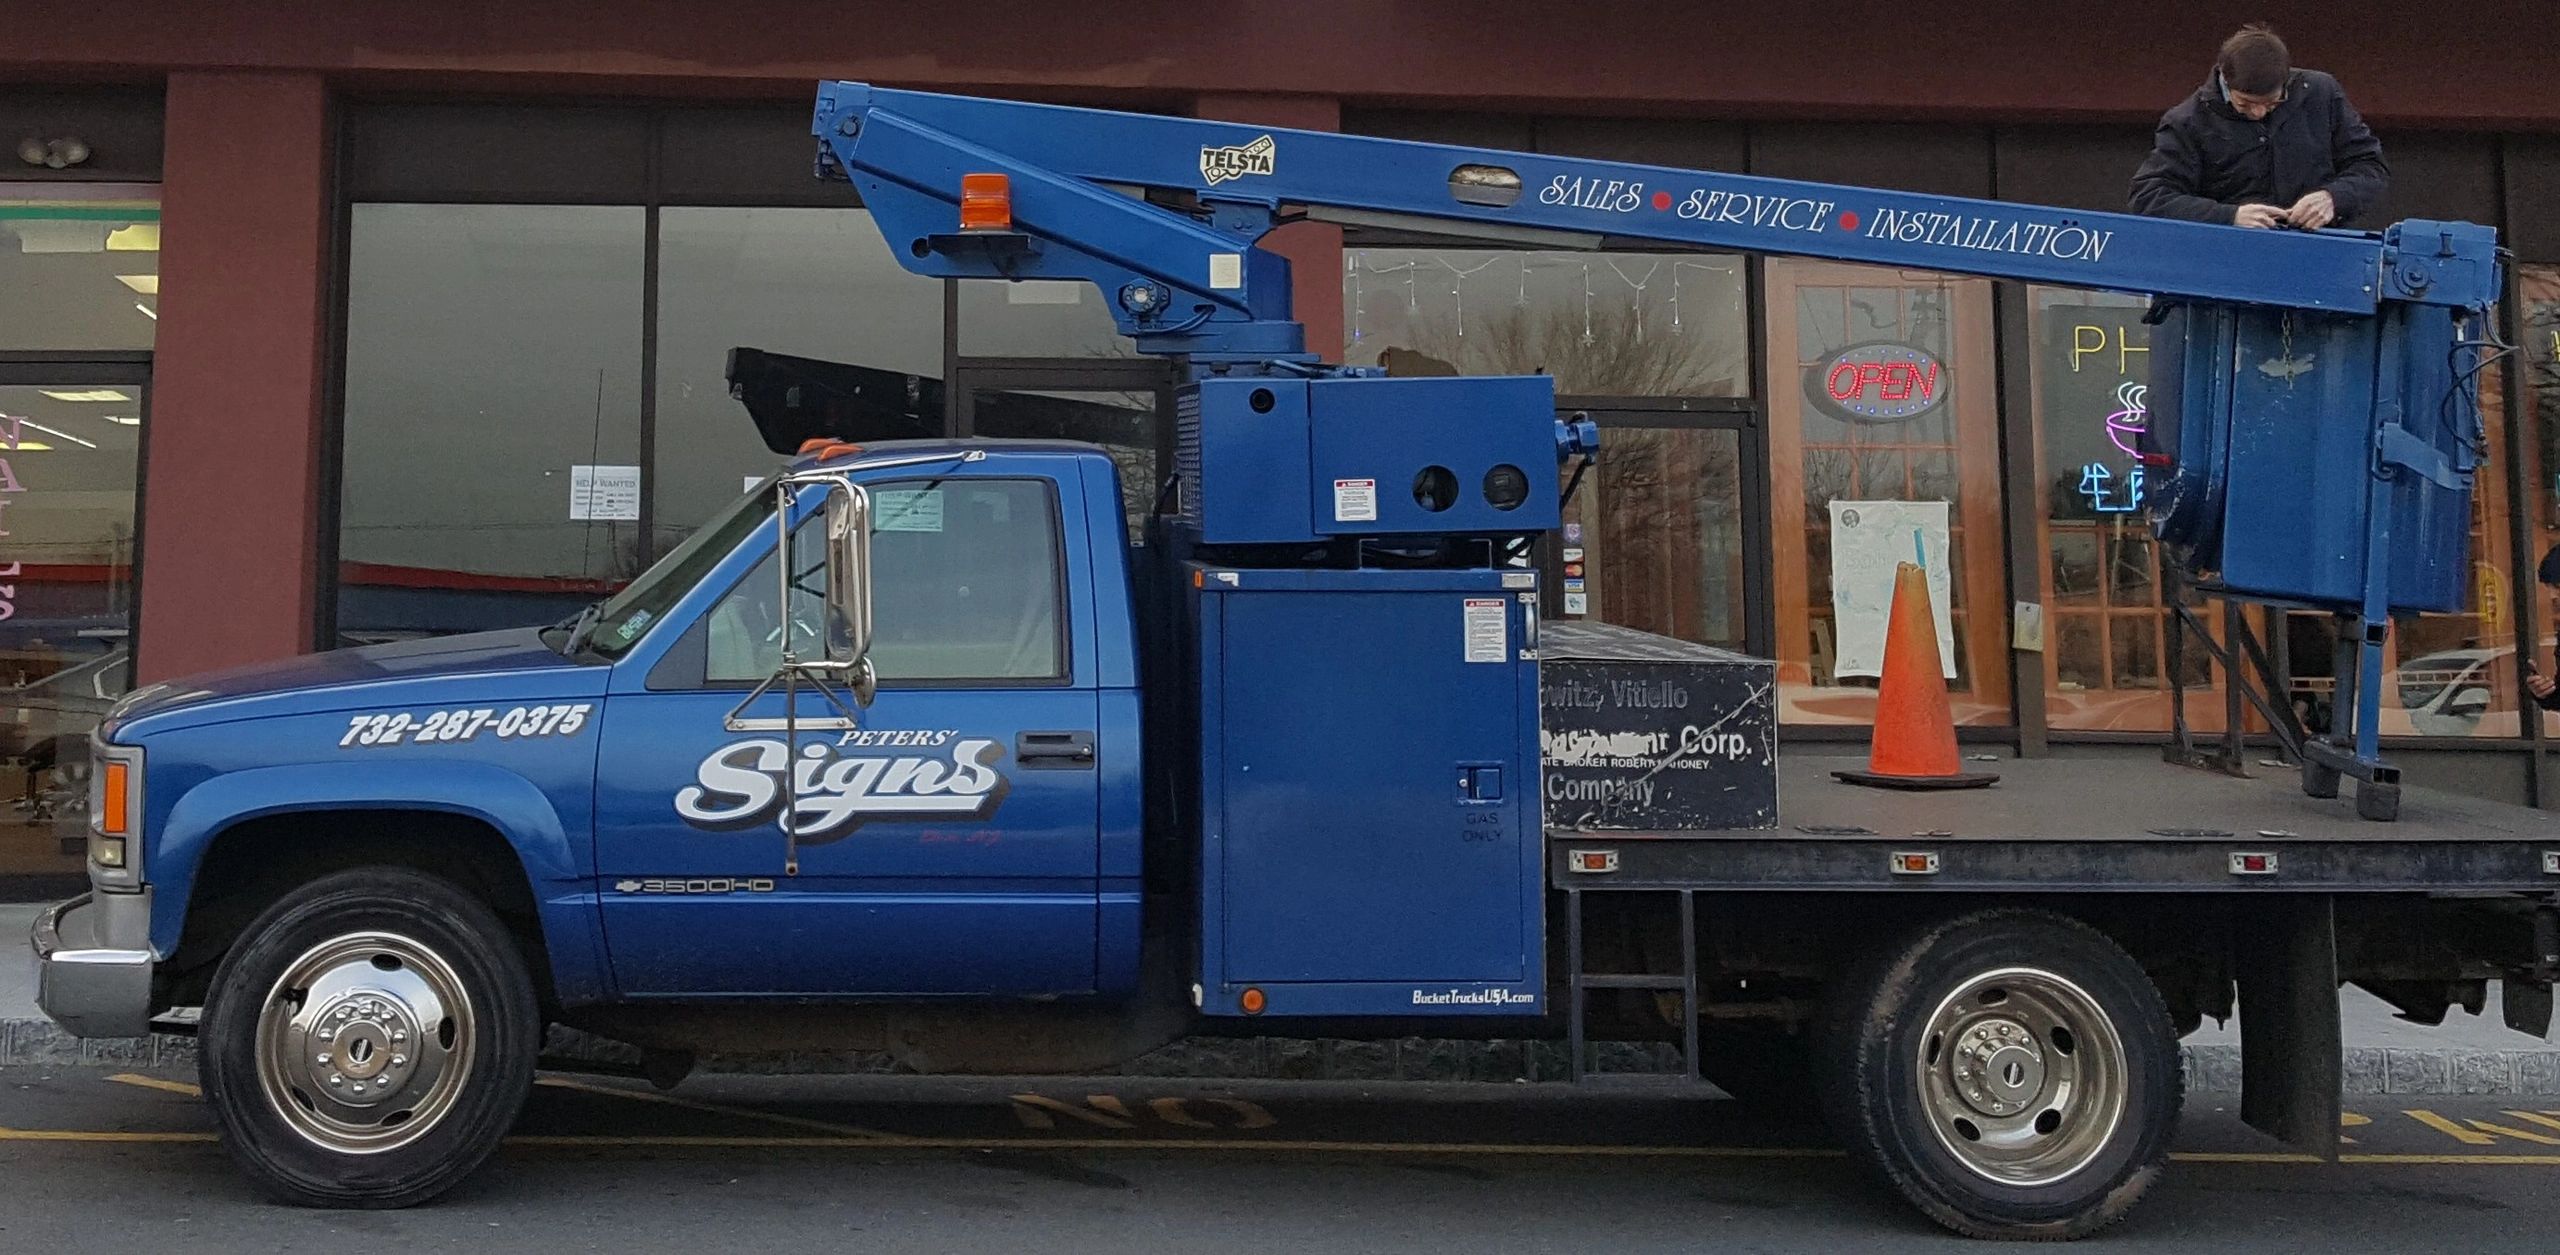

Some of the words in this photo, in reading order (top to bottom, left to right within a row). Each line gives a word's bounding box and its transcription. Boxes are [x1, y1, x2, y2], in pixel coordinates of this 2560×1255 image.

[1203, 149, 1271, 173] TELSTA
[1539, 174, 1644, 213] SALES
[1677, 188, 1834, 233] SERVICE
[1865, 207, 2114, 263] INSTALLATION
[1827, 362, 1938, 400] OPEN
[1611, 679, 1688, 708] Vitiello
[339, 704, 592, 747] 732-287-0375
[836, 729, 958, 747] PETERS'
[1680, 725, 1752, 761] Corp.
[674, 738, 1001, 836] Signs
[1466, 812, 1499, 825] GAS
[1462, 829, 1503, 842] ONLY
[642, 879, 774, 893] 3500HD
[1412, 988, 1534, 1006] BucketTrucksUSA.com
[1008, 1094, 1279, 1129] NO
